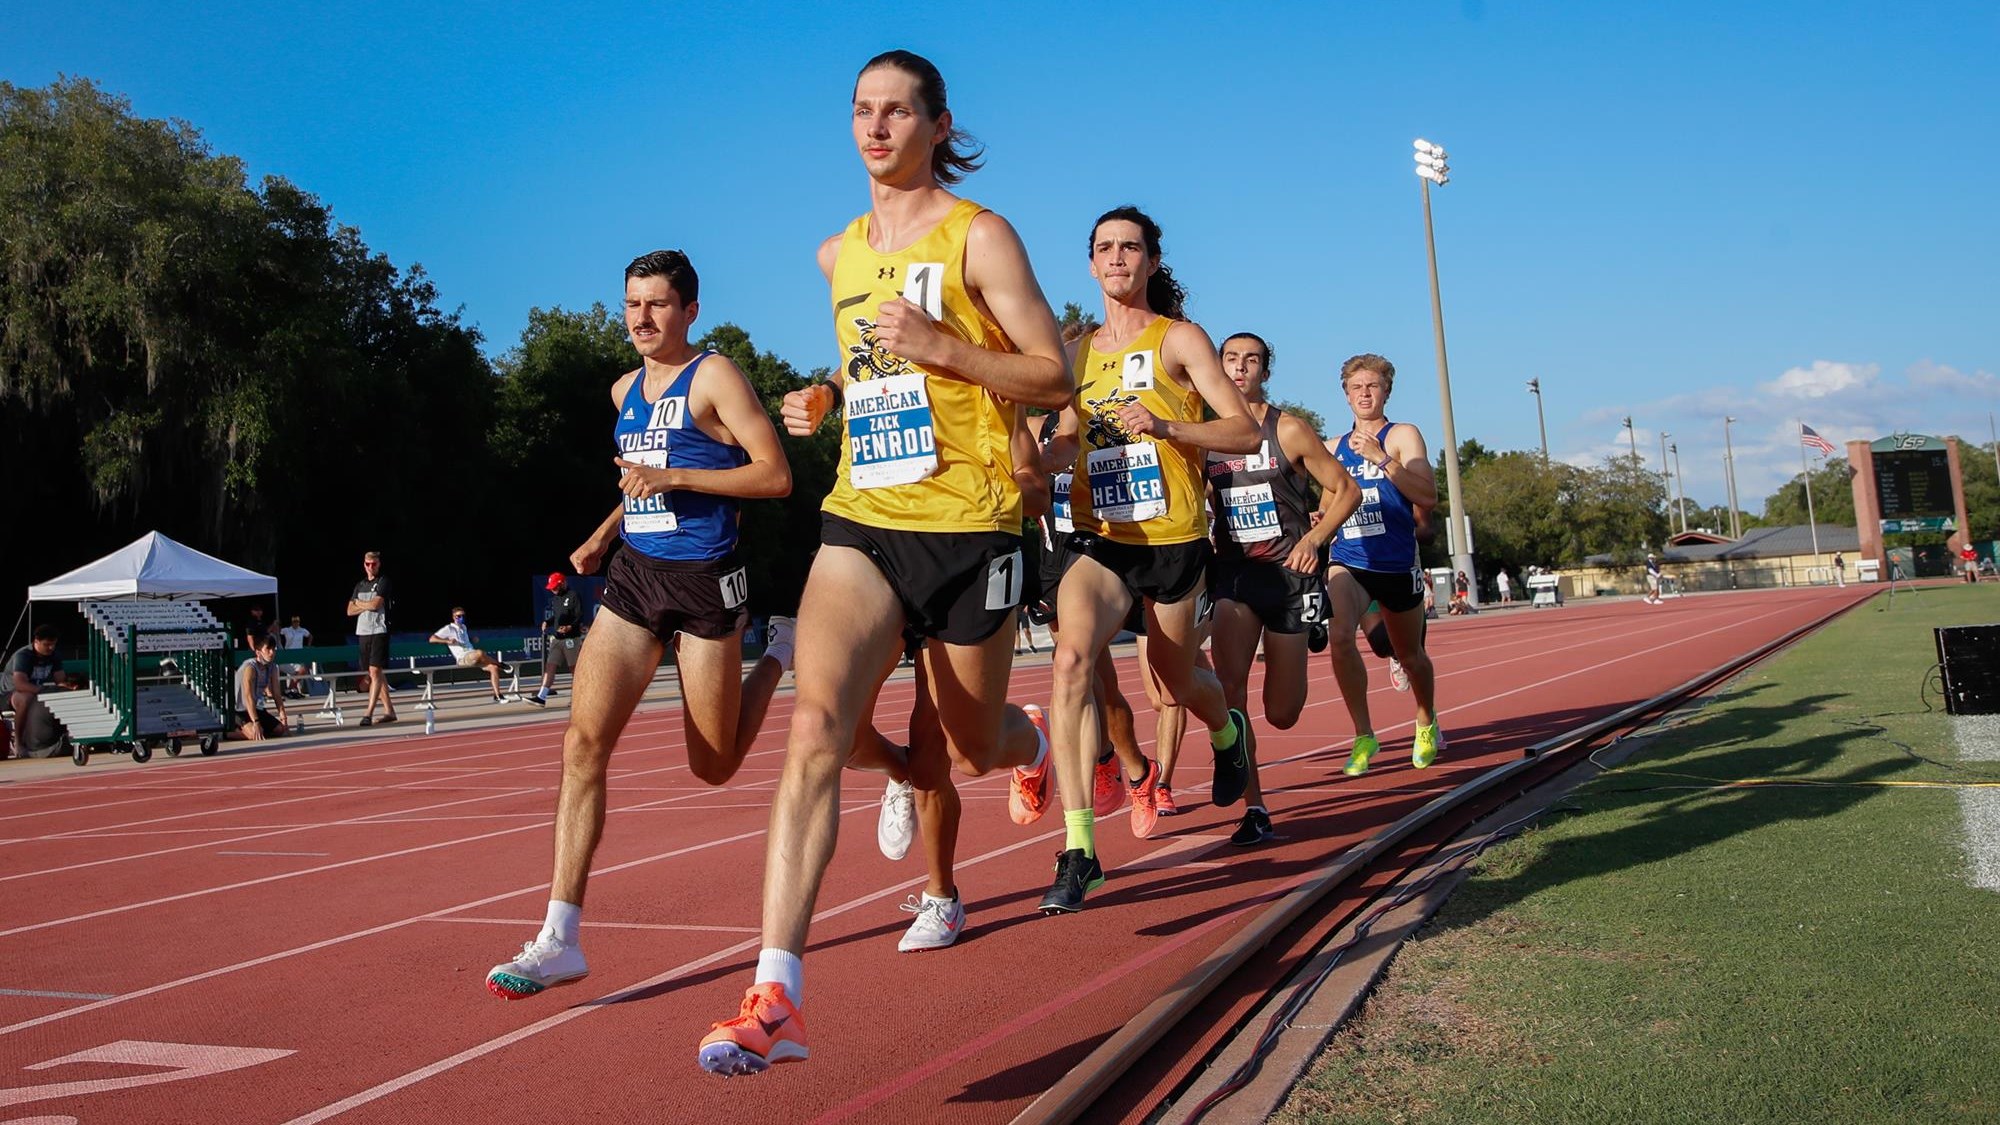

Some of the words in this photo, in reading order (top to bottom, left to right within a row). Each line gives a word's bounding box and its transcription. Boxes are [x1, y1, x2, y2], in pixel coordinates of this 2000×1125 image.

[915, 266, 932, 318] 1
[1128, 353, 1148, 388] 2
[656, 399, 677, 428] 10
[849, 390, 922, 417] AMERICAN
[869, 415, 900, 432] ZACK
[619, 430, 668, 452] TULSA
[850, 425, 934, 463] PENROD
[1090, 453, 1153, 474] AMERICAN
[1115, 472, 1132, 484] JED
[1092, 478, 1163, 507] HELKER
[1224, 492, 1270, 507] AMERICAN
[1227, 510, 1279, 530] VALLEJO
[1238, 506, 1259, 515] DEVIN
[1342, 511, 1383, 527] HNSON
[726, 572, 746, 605] 10
[998, 556, 1014, 605] 1
[1415, 574, 1424, 591] 6
[1305, 595, 1321, 621] 5
